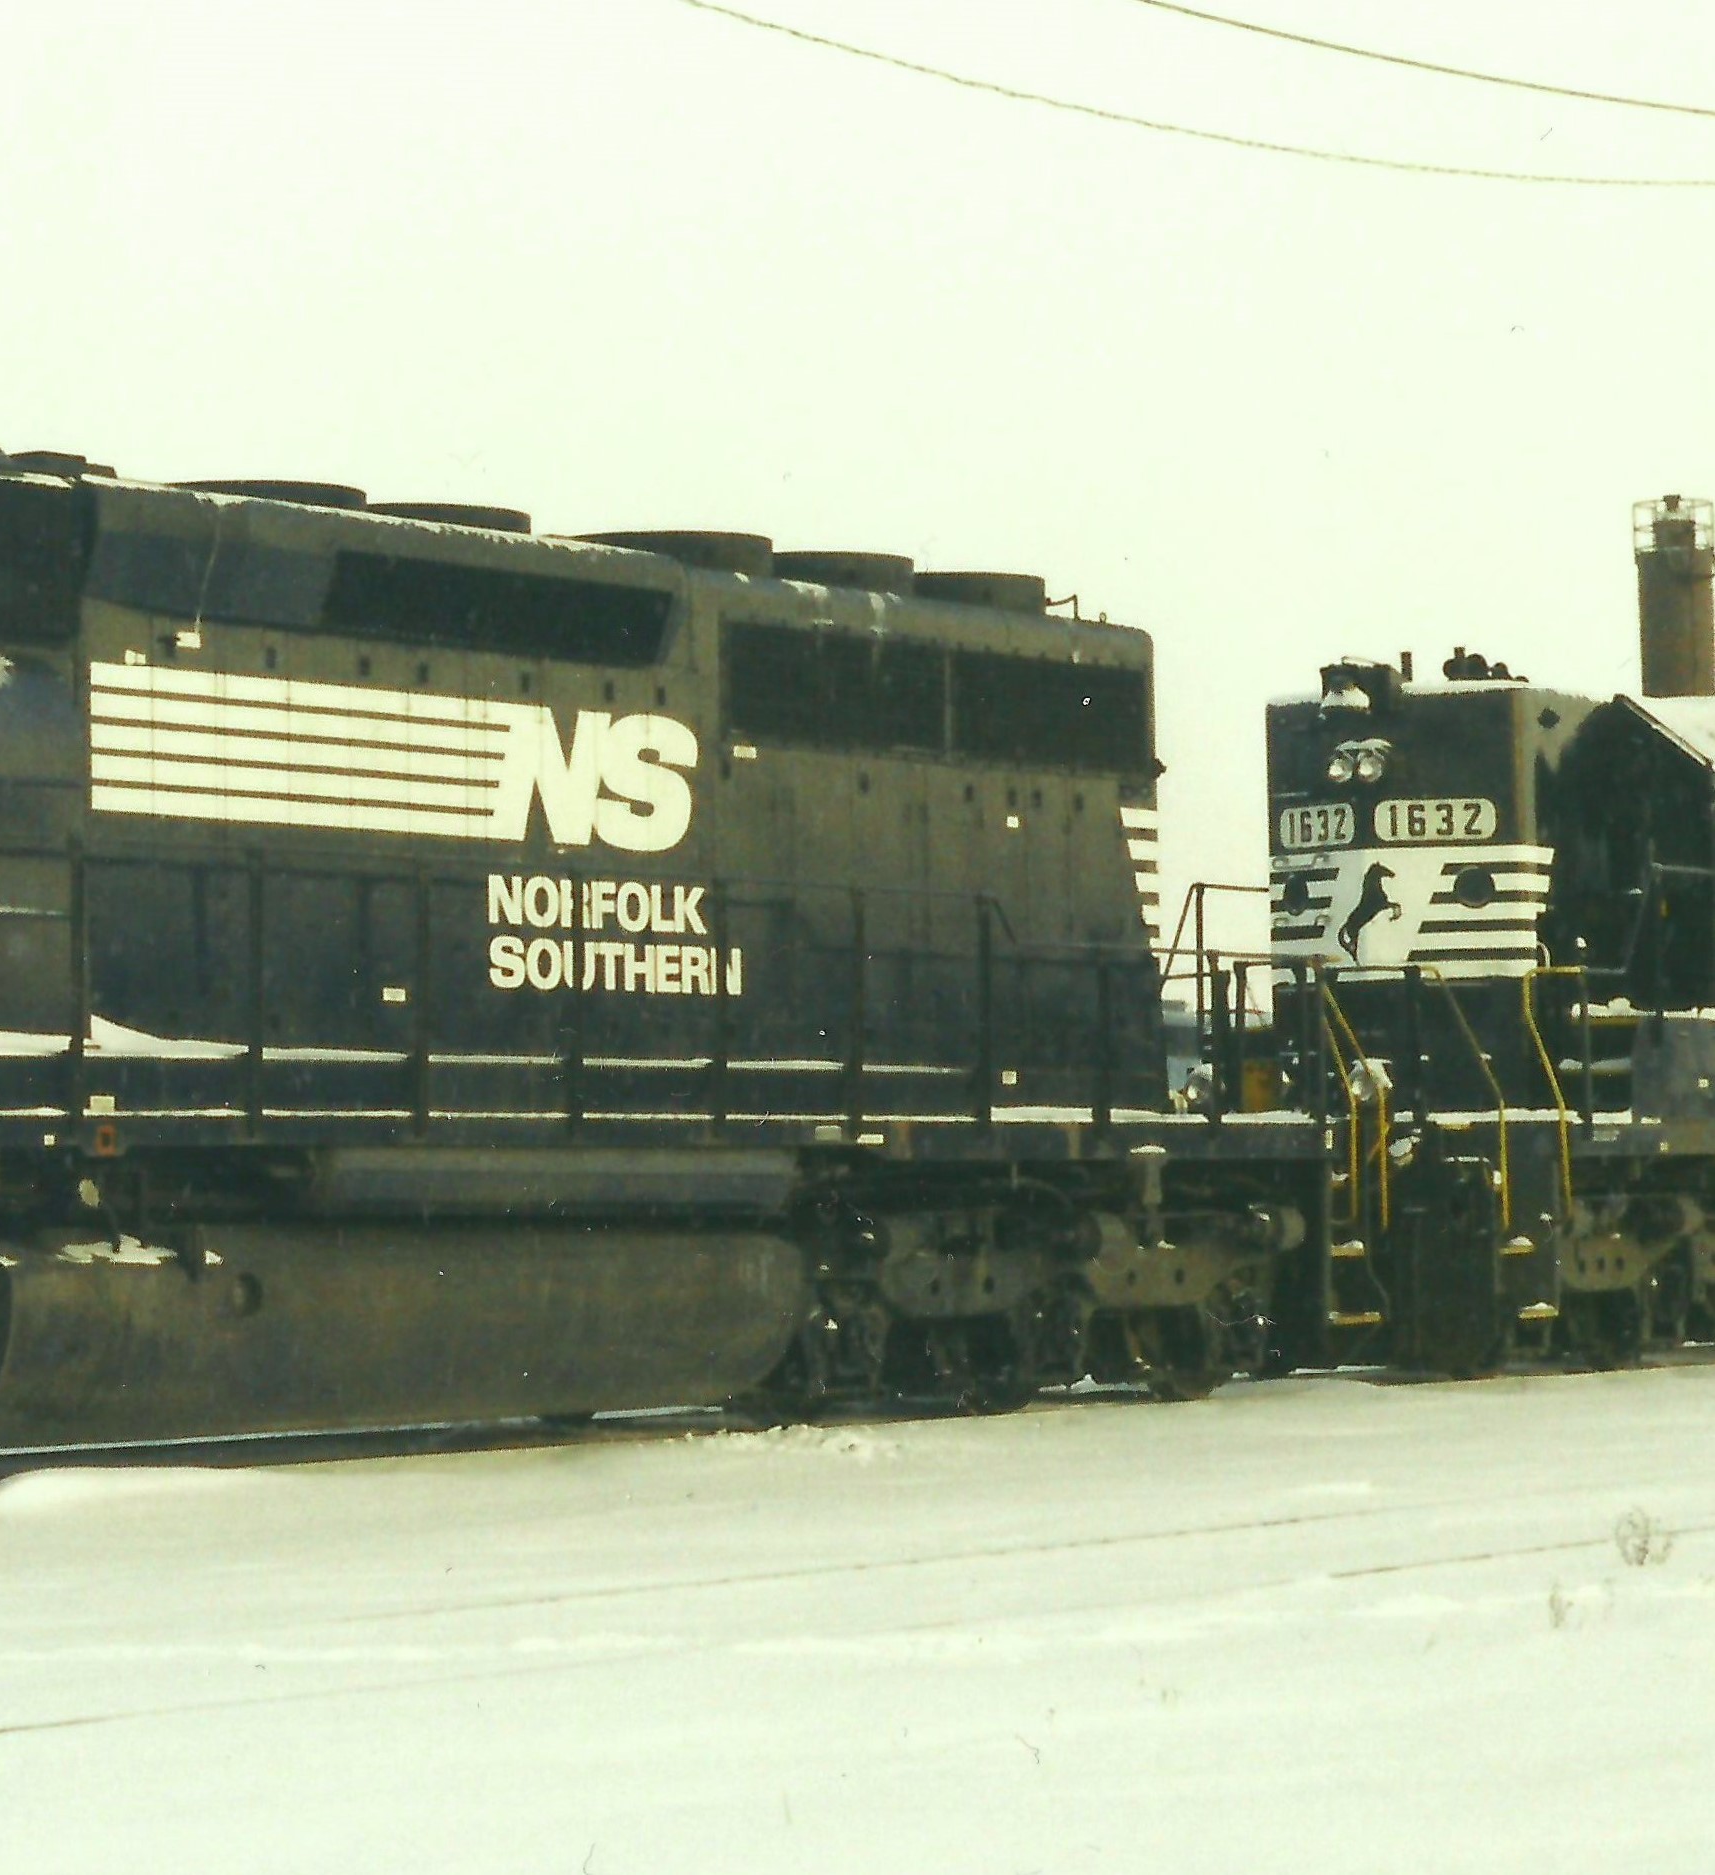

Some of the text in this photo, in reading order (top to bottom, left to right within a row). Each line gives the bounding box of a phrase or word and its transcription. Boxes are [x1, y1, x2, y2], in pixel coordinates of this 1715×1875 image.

[490, 700, 699, 852] NS
[1288, 807, 1347, 844] 1632
[1388, 801, 1484, 838] 1632
[487, 873, 707, 935] NORFOLK
[489, 935, 743, 996] SOUTHERN
